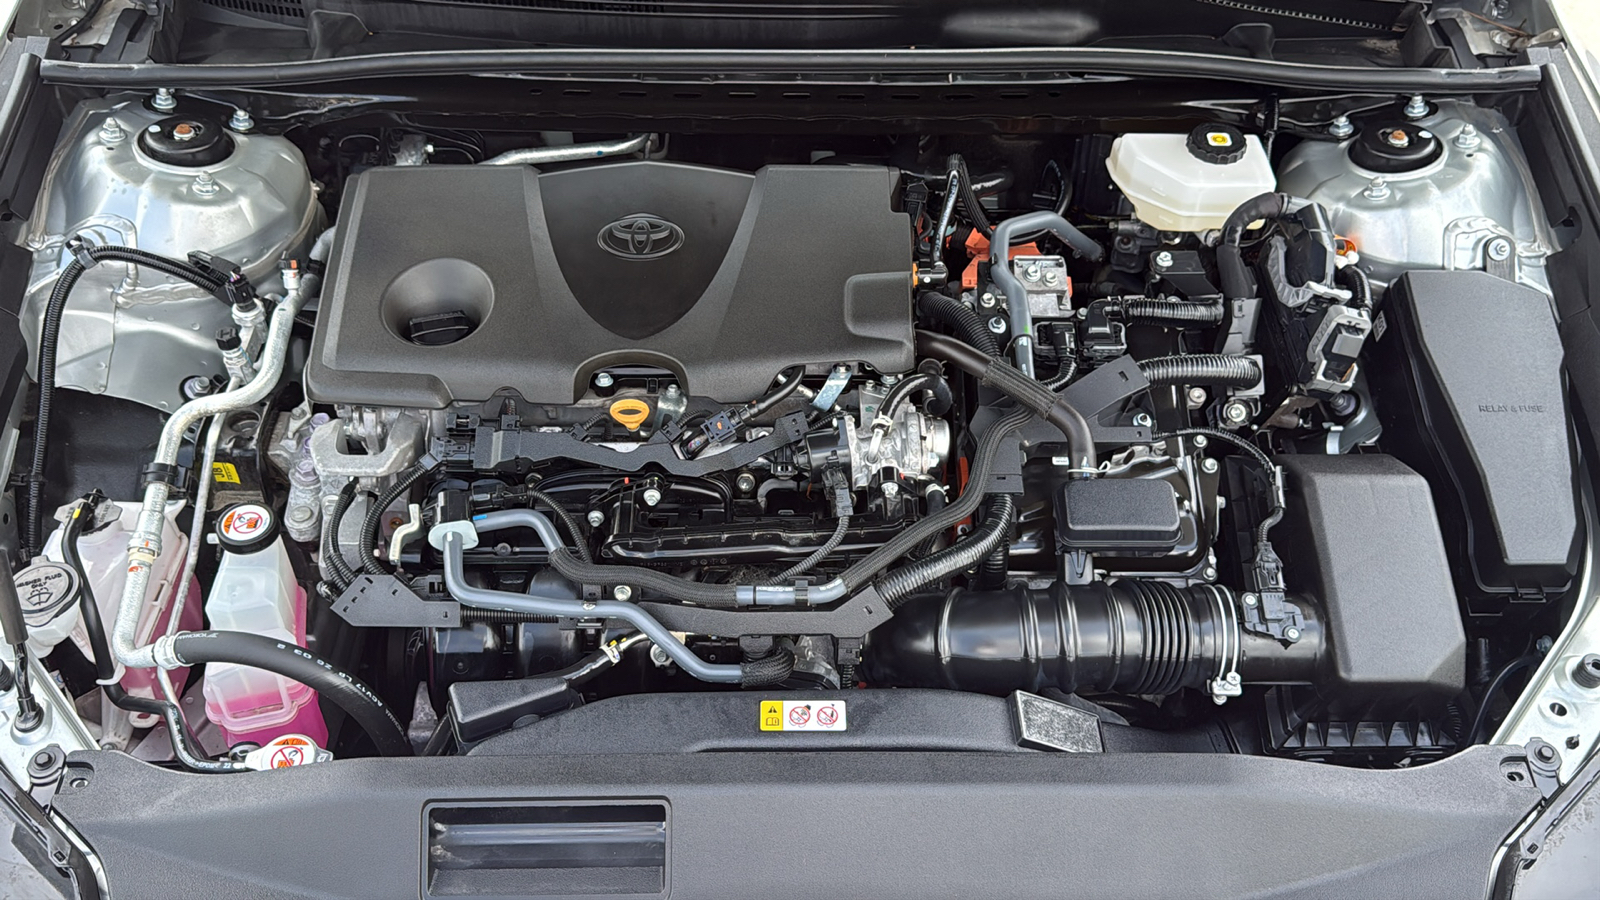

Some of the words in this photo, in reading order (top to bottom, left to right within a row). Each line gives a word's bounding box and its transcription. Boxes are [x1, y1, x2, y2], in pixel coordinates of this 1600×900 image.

[1478, 404, 1508, 413] RELAY
[1518, 404, 1544, 413] FUSE
[16, 577, 42, 588] WASHER
[44, 572, 63, 581] FLUID
[31, 581, 48, 589] ONLY
